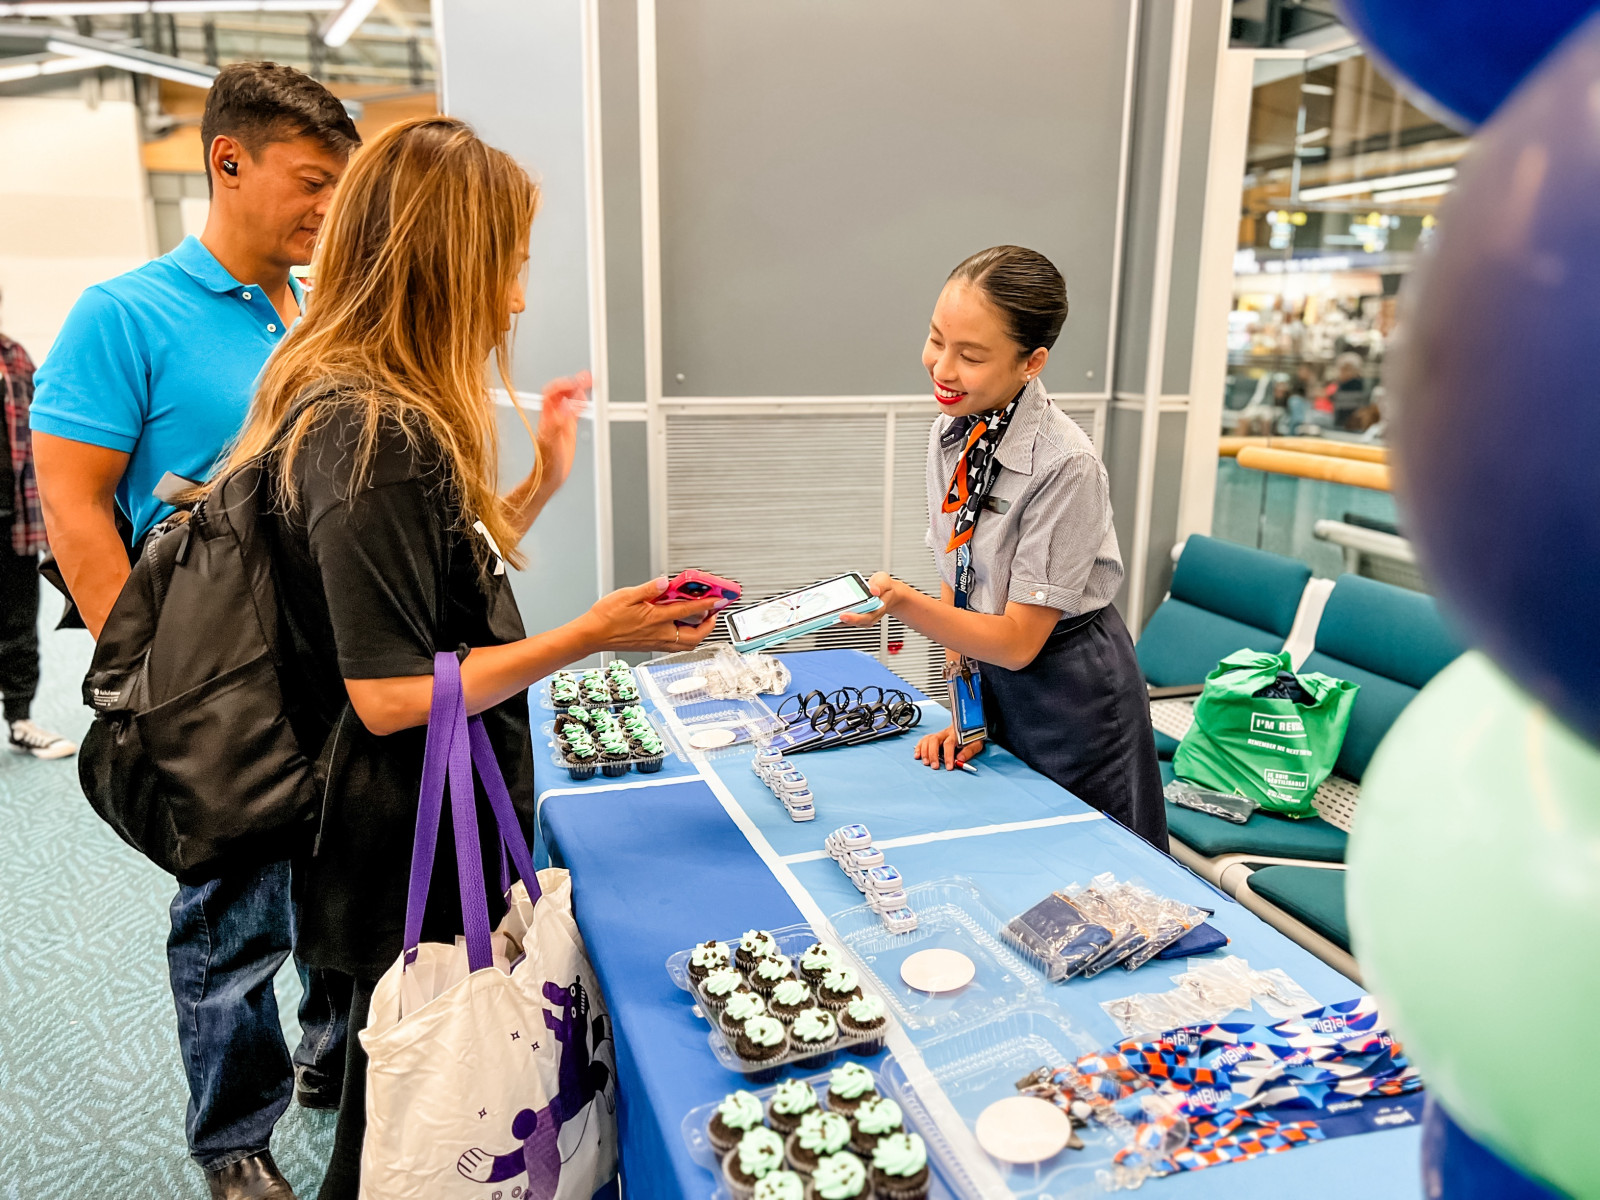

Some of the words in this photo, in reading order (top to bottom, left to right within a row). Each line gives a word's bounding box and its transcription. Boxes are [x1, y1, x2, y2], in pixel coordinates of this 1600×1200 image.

[1256, 719, 1275, 730] I'M
[1248, 738, 1276, 750] REMEMBER
[1185, 1087, 1232, 1112] jetBlue
